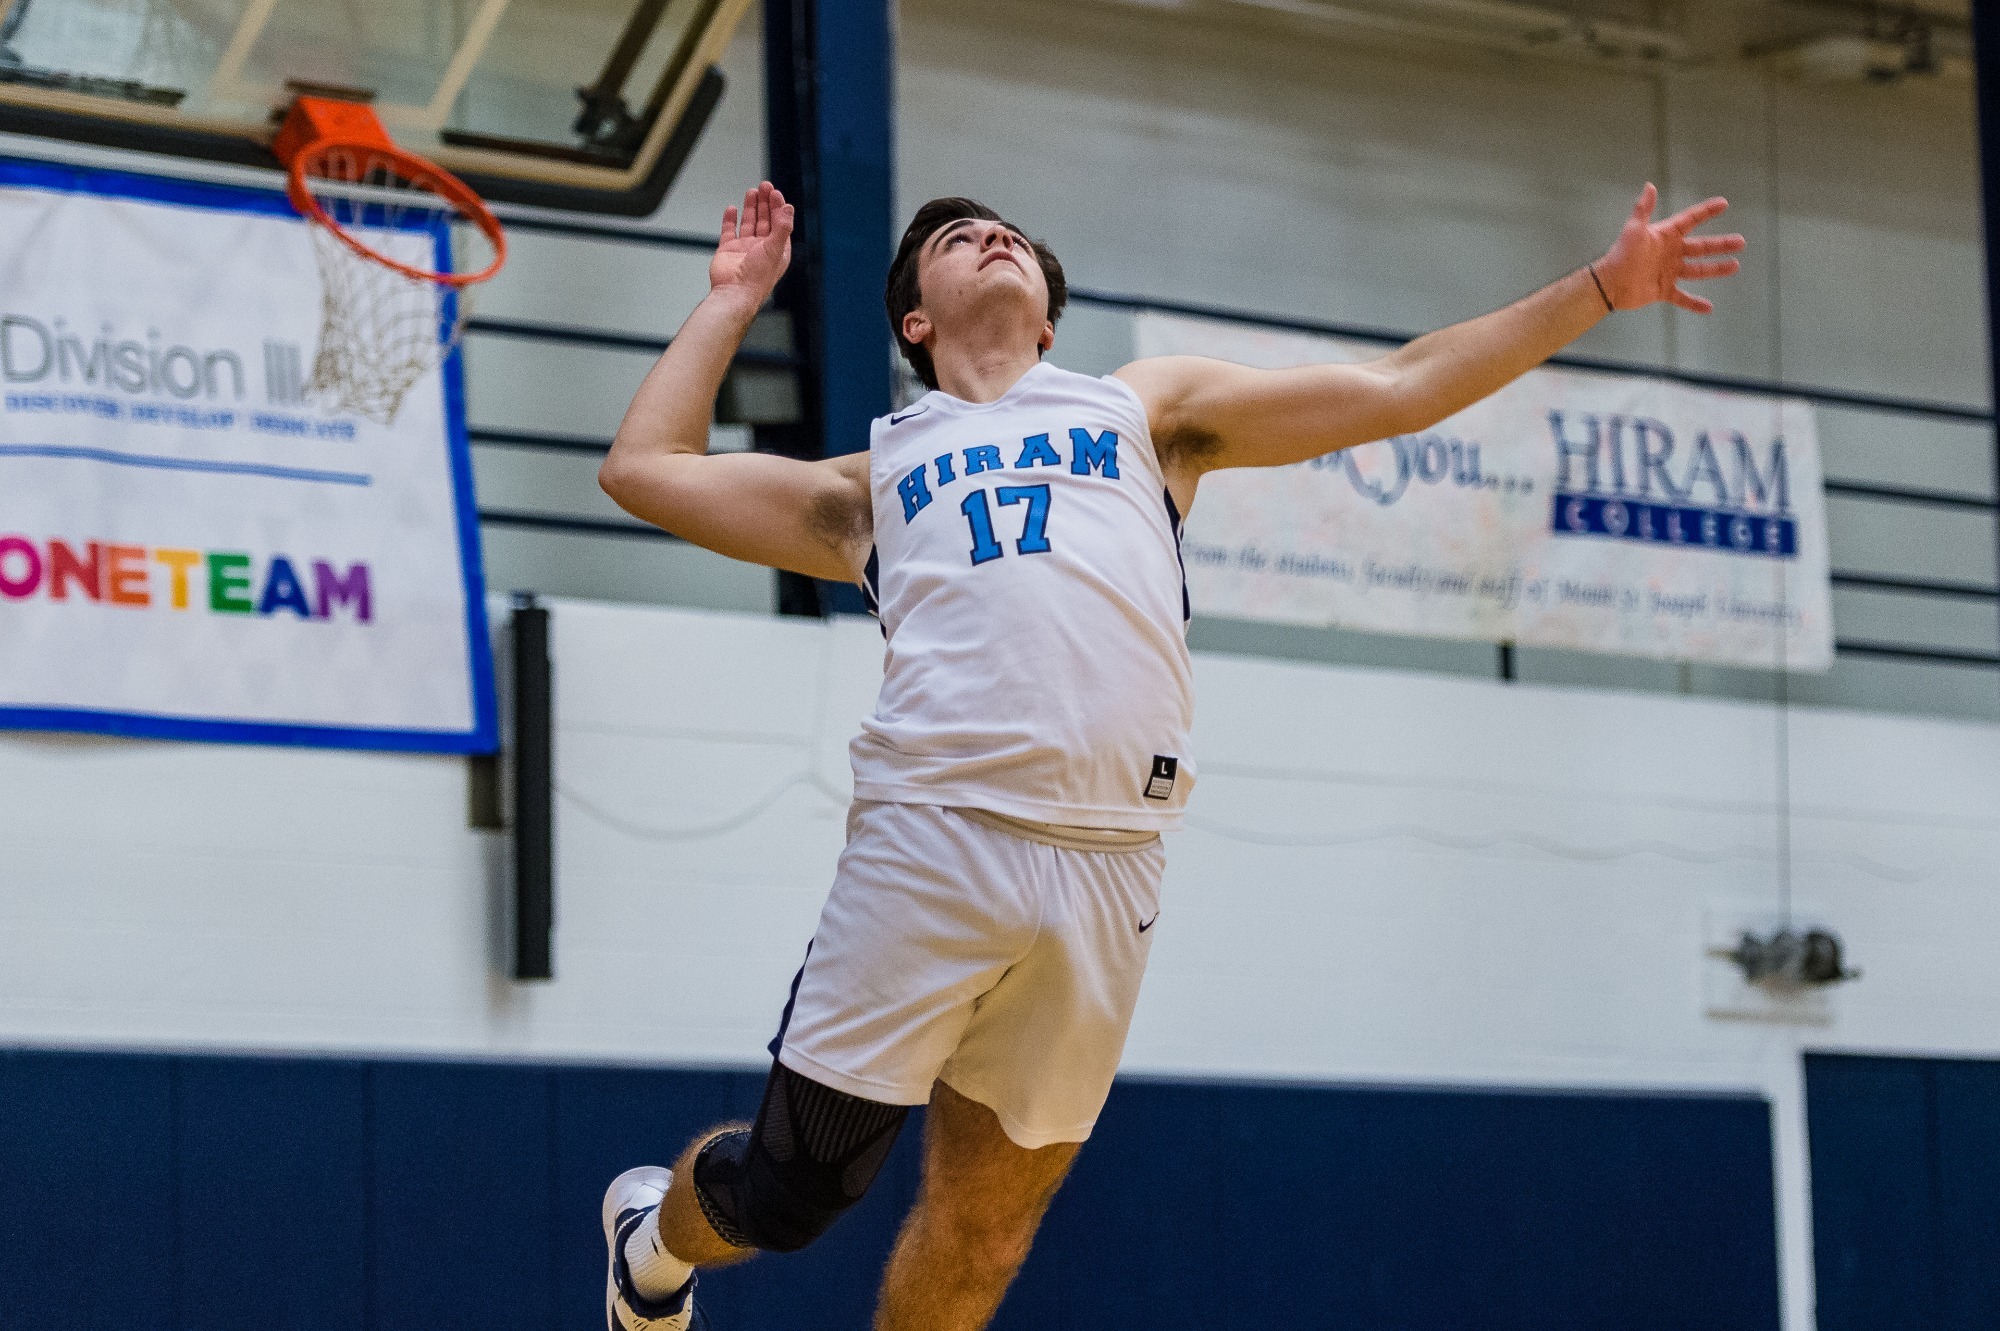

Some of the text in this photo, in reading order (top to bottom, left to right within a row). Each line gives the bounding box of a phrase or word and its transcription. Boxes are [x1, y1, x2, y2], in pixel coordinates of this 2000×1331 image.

[1, 312, 247, 400] Division
[897, 427, 1121, 526] HIRAM
[1548, 411, 1790, 514] HIRAM
[960, 483, 1053, 567] 17
[1563, 499, 1783, 550] COLLEGE
[1161, 761, 1168, 775] L
